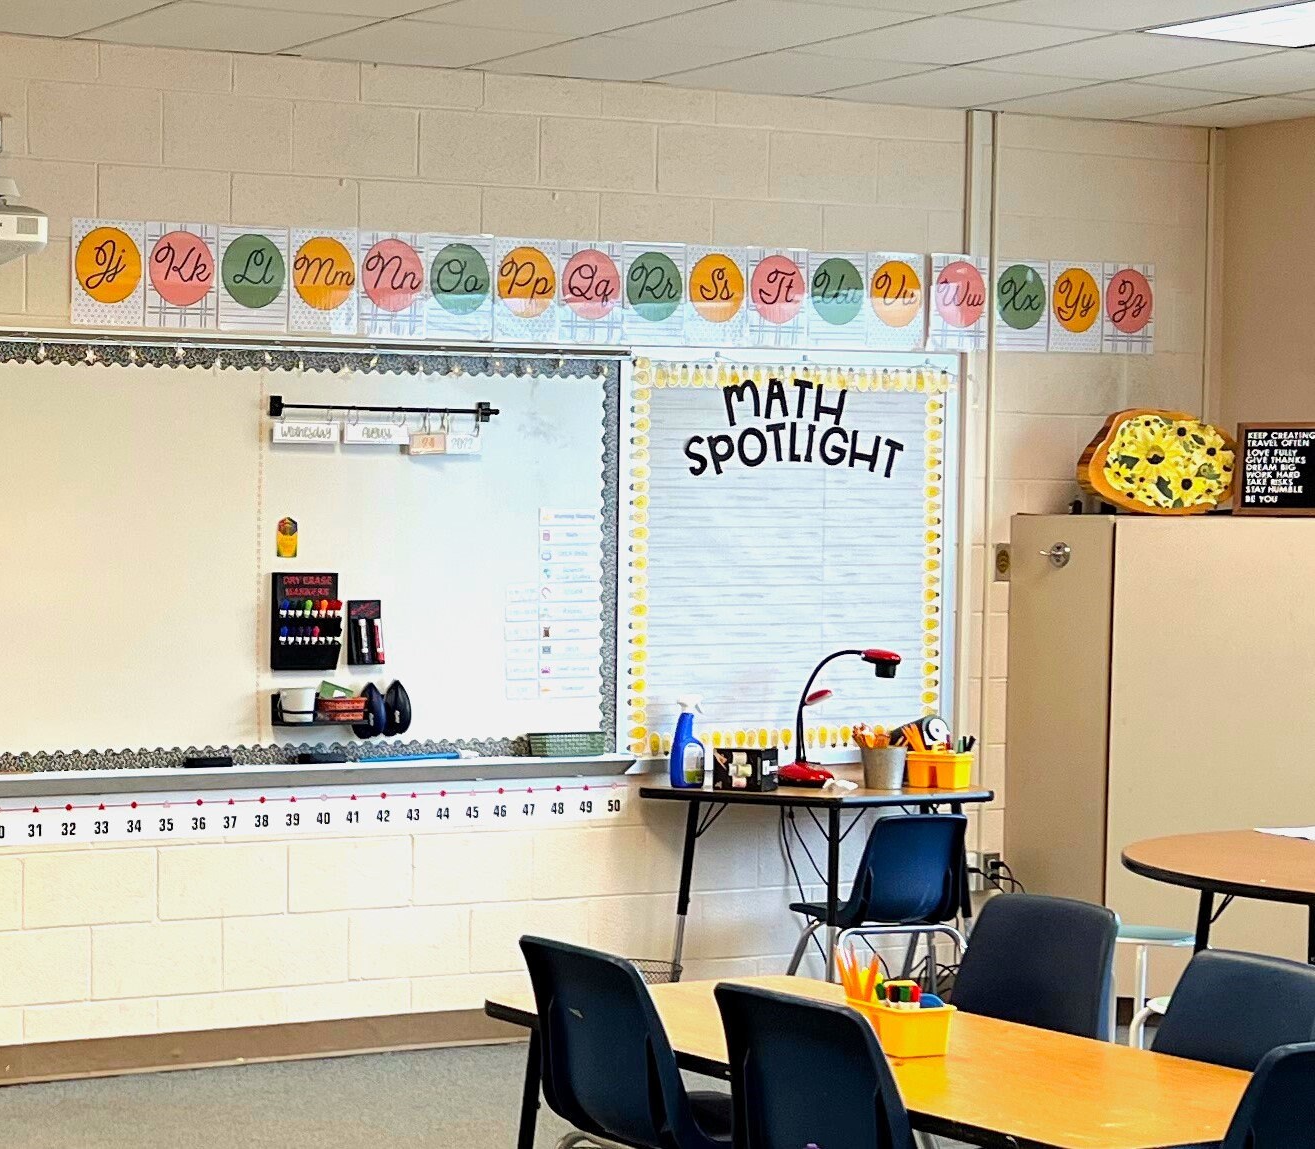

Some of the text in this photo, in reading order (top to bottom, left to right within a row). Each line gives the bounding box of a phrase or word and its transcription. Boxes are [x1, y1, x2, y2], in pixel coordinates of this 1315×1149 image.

[86, 239, 1147, 323] Jj Kk Ll Mm Nn Oo Pp Qq Rr Ss Tt Uu Vv Ww Xx Yy Zz
[723, 377, 847, 427] MATH
[1271, 432, 1315, 440] CREATING
[684, 421, 904, 479] SPOTLIGHT
[1247, 449, 1270, 457] LOVE
[1271, 456, 1306, 464] THANKS
[1246, 471, 1273, 479] WORK
[1245, 495, 1278, 503] BE YOU
[283, 576, 333, 585] DRY ERASE
[28, 824, 41, 837] 31
[62, 823, 75, 835] 32
[95, 821, 108, 834] 33
[127, 820, 141, 832] 34
[159, 819, 173, 831] 35
[192, 817, 205, 830] 36
[224, 816, 236, 828] 37
[255, 815, 268, 827] 38
[286, 813, 299, 826] 39
[317, 812, 330, 824] 40
[347, 811, 358, 823] 41
[377, 810, 389, 822] 42
[407, 809, 419, 820] 43
[437, 808, 449, 819] 44
[466, 807, 478, 818] 45
[494, 805, 506, 817] 46
[523, 804, 534, 815] 47
[551, 803, 564, 814] 48
[580, 801, 592, 813] 49
[608, 800, 620, 812] 50
